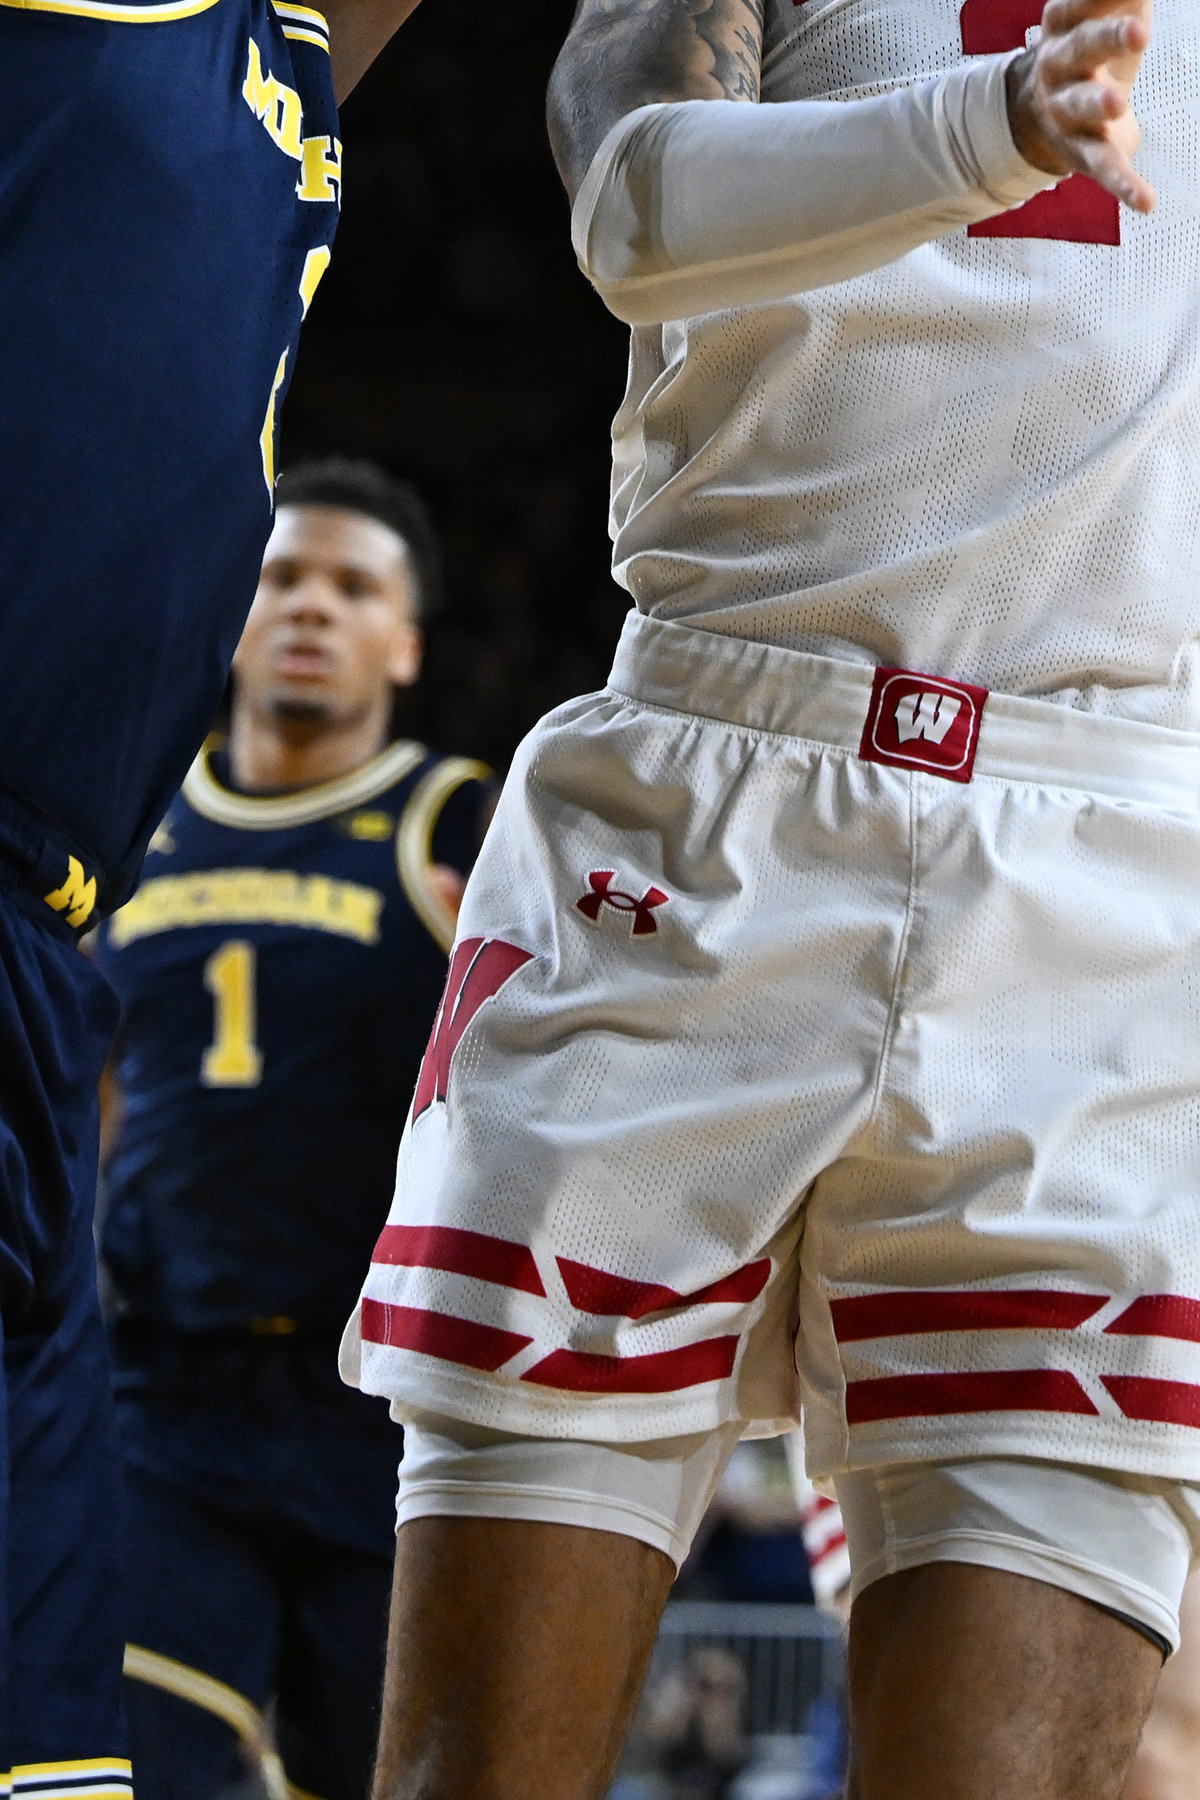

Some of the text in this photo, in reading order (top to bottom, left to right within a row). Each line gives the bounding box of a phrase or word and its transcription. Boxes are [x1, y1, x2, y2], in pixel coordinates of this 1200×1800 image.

[893, 692, 962, 745] W
[43, 853, 97, 928] M
[203, 938, 262, 1088] 1
